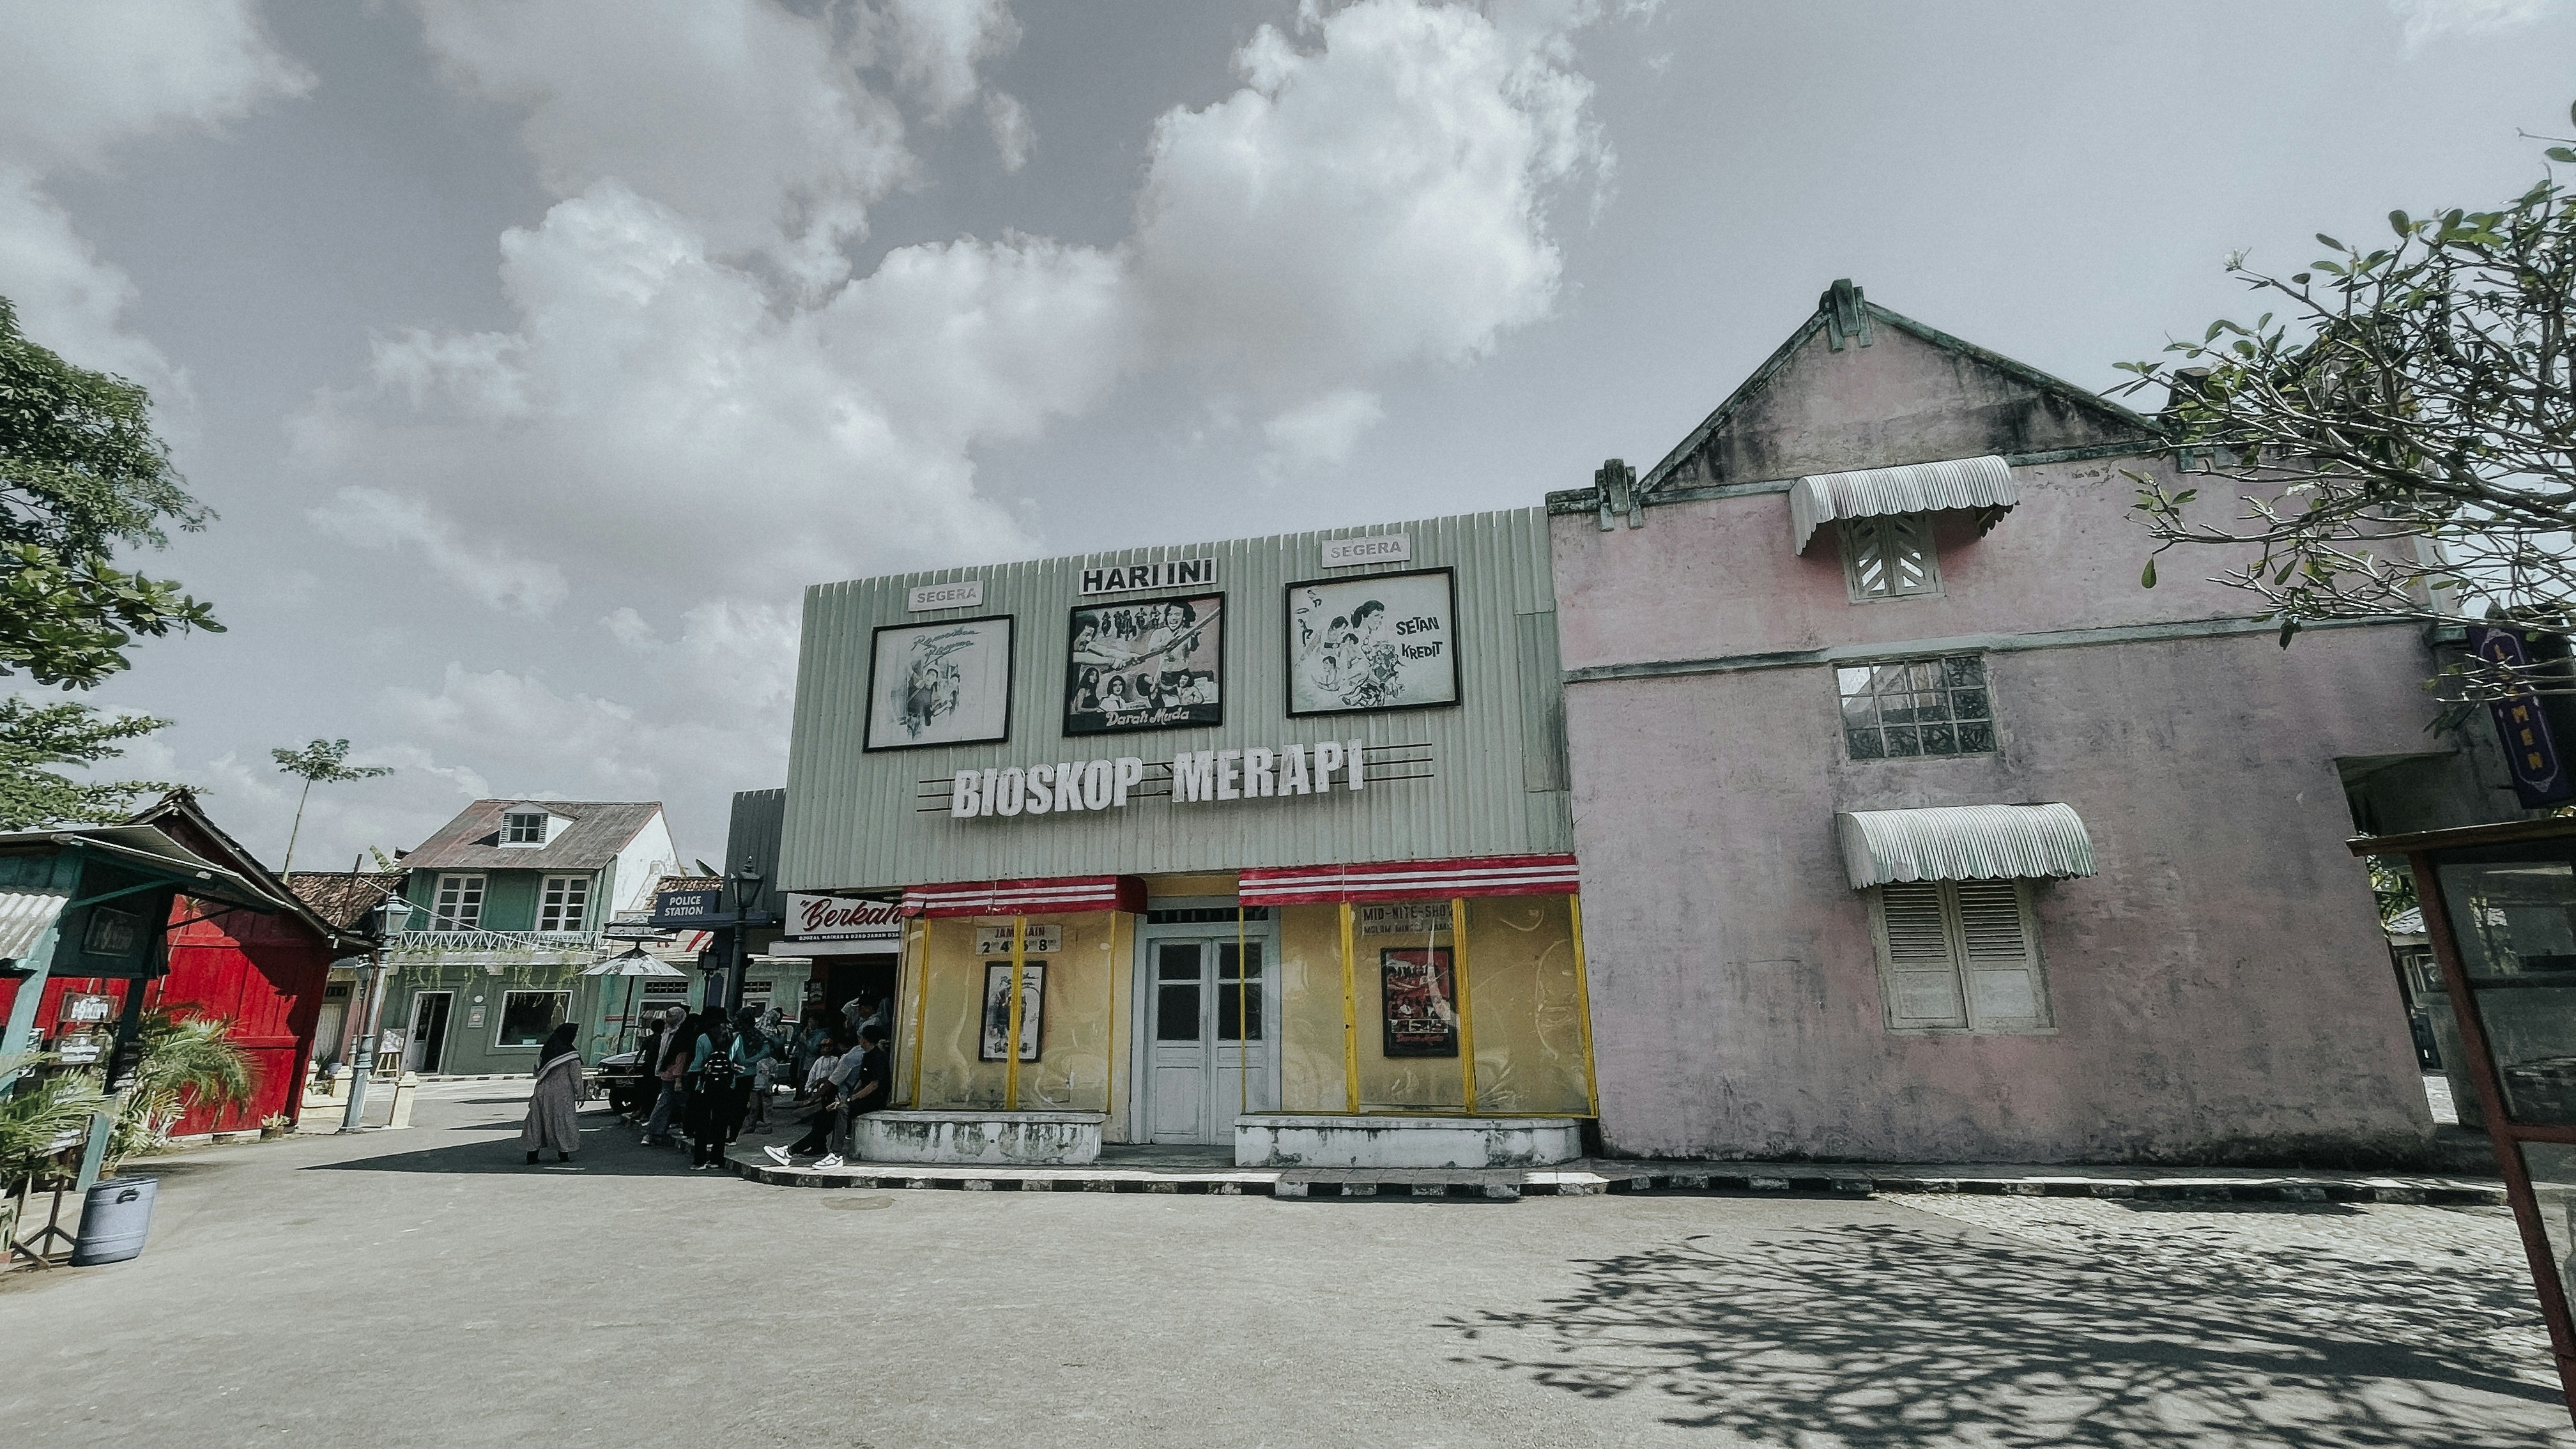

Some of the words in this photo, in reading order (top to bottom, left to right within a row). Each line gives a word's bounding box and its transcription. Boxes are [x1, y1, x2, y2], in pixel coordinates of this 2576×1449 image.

[1330, 540, 1402, 559] SEGERA
[1083, 564, 1158, 593] HARI
[1167, 559, 1213, 585] INI
[917, 587, 976, 604] SEGERA
[1395, 616, 1440, 636] SETAN
[1401, 641, 1443, 660] KREDIT
[1105, 710, 1149, 726] Darah
[1149, 707, 1190, 725] Muda
[951, 756, 1143, 818] BIOSKOP
[1172, 739, 1363, 803] MERAPI
[670, 896, 702, 906] POLICE
[664, 906, 703, 916] STATION
[981, 941, 991, 954] 2
[1000, 940, 1009, 953] 4
[1038, 939, 1048, 951] 8
